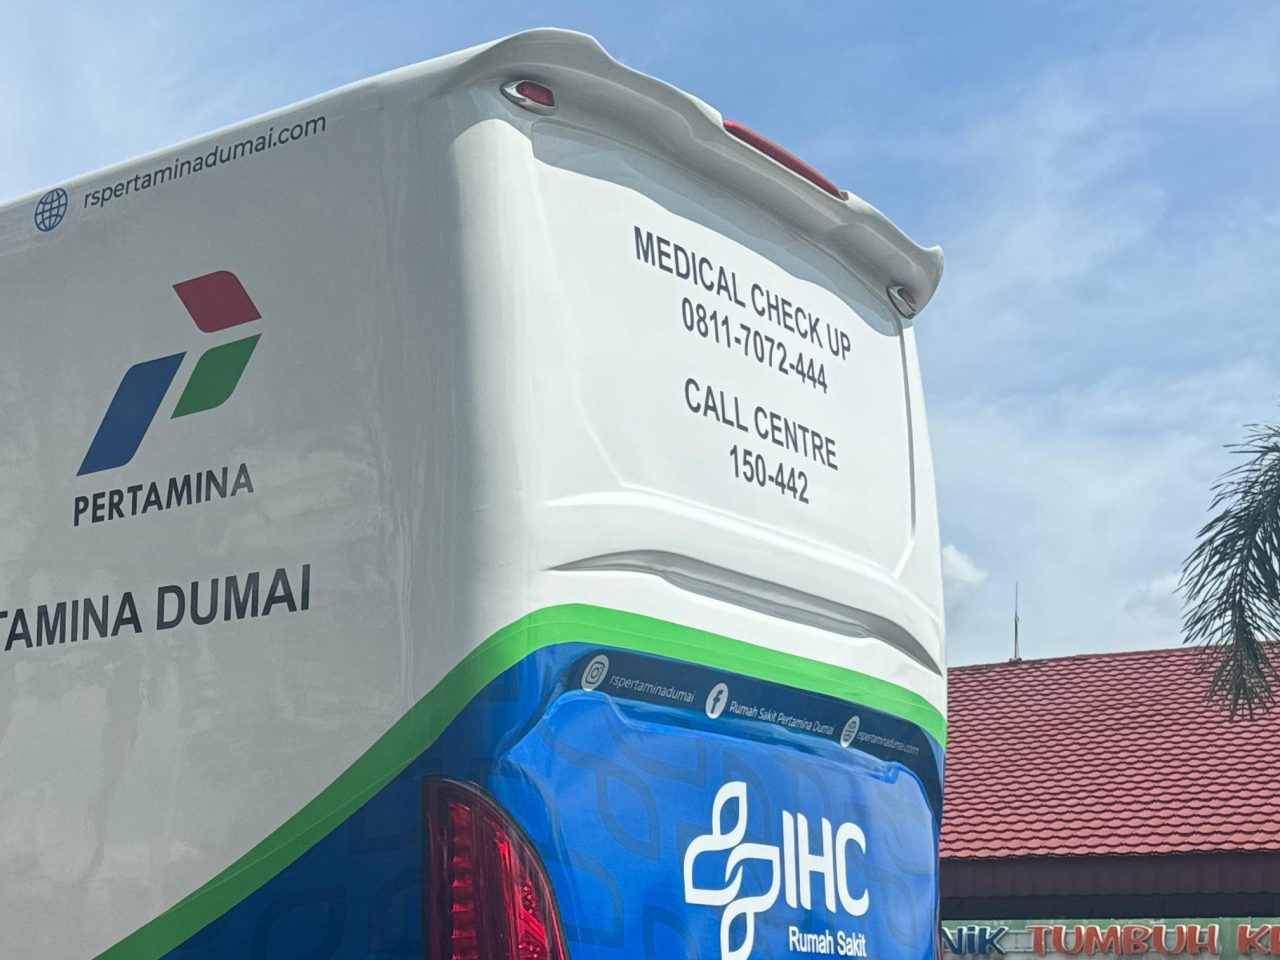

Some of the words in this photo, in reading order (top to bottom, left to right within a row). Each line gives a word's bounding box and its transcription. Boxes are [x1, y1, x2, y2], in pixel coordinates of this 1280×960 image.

[82, 115, 327, 208] rspertaminadumai.com
[633, 225, 746, 308] MEDICAL
[751, 283, 823, 348] CHECK
[826, 323, 851, 361] UP
[681, 297, 828, 394] 0811-7072-444
[684, 378, 749, 433] CALL
[754, 406, 838, 471] CENTRE
[73, 462, 255, 526] PERTAMINA
[730, 444, 809, 504] 150-442
[156, 563, 312, 630] DUMAI
[609, 675, 697, 703] rspertaminadumai
[729, 701, 758, 717] Rumah
[758, 708, 777, 722] Sakit
[777, 712, 813, 730] Pertamina
[812, 721, 836, 735] Dumai
[782, 810, 869, 917] IHC
[788, 925, 835, 954] Rumah
[836, 931, 867, 957] Sakit
[1026, 924, 1219, 955] TUMBUH
